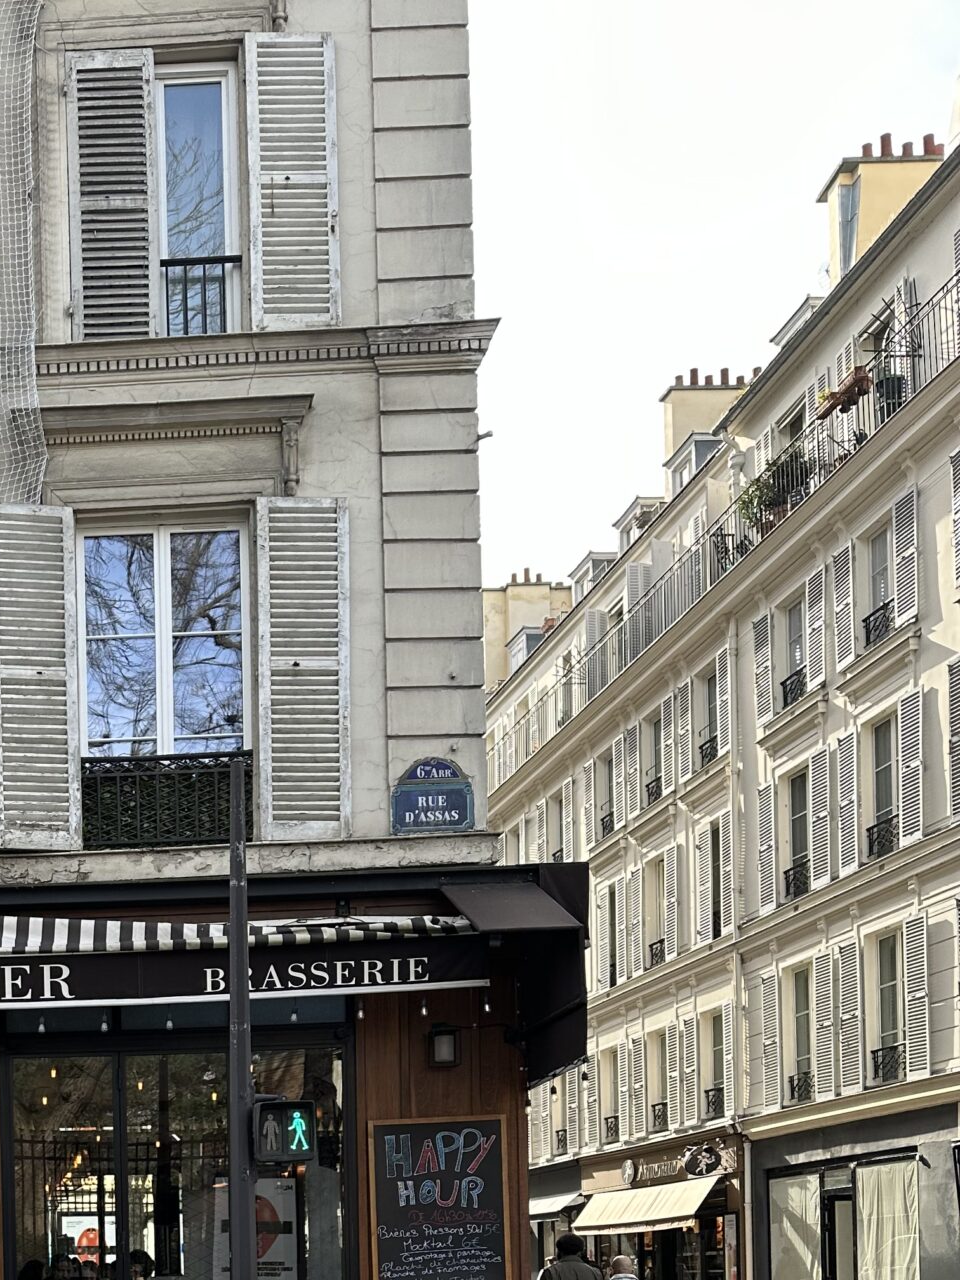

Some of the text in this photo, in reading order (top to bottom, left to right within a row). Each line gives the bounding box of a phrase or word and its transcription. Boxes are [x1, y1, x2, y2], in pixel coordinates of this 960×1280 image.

[418, 795, 447, 807] RUE
[405, 810, 459, 823] D'ASSAS
[384, 1128, 497, 1178] HAPPY
[397, 1176, 485, 1209] HOUR
[403, 1235, 454, 1252] Mocktail
